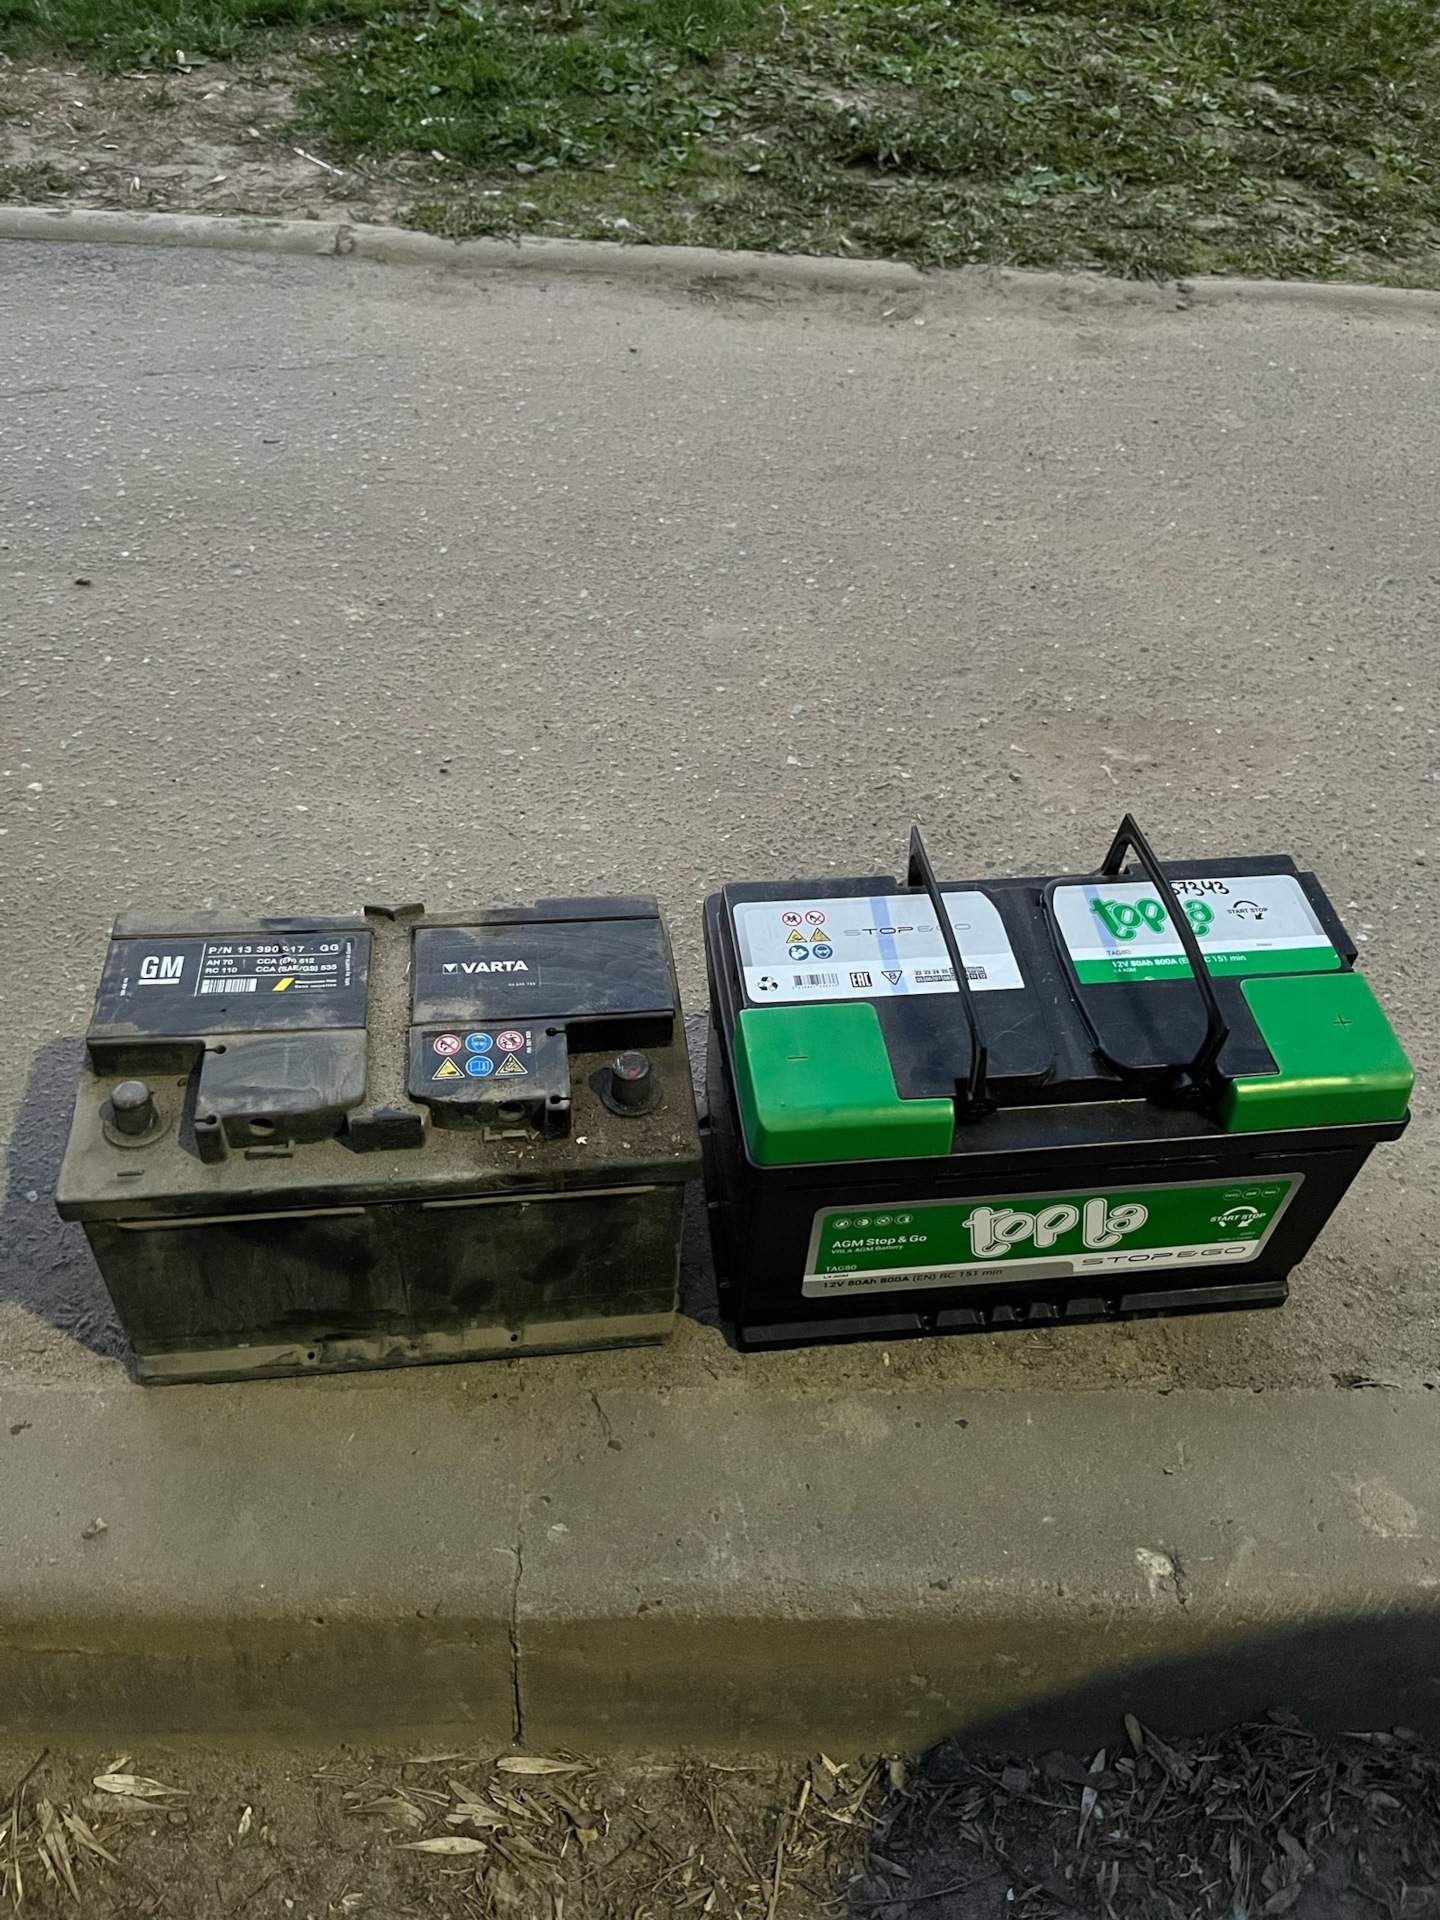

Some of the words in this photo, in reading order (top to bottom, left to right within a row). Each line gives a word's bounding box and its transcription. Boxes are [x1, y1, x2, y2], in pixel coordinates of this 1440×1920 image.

[1090, 897, 1215, 941] topa
[843, 923, 971, 937] STOP&O
[208, 946, 233, 955] P/N
[237, 945, 252, 954] 13
[256, 945, 279, 953] 390
[319, 943, 339, 953] GG
[140, 955, 185, 979] GM
[222, 958, 234, 966] 70
[460, 960, 529, 974] VARTA
[1155, 958, 1178, 966] 800A
[1212, 955, 1227, 963] 151
[221, 966, 238, 974] 110
[255, 965, 276, 973] CCA
[1210, 1213, 1241, 1223] START
[1240, 1212, 1267, 1221] STOP
[962, 1197, 1149, 1258] topla
[832, 1239, 864, 1248] AGM
[866, 1237, 896, 1246] Stop
[897, 1235, 907, 1243] &
[909, 1234, 927, 1243] Go
[825, 1264, 857, 1272] TAG80
[823, 1281, 845, 1289] 12V
[848, 1278, 877, 1286] 80Ah
[880, 1275, 909, 1284] 800A
[912, 1273, 936, 1283] (EN)
[981, 1268, 1003, 1276] min
